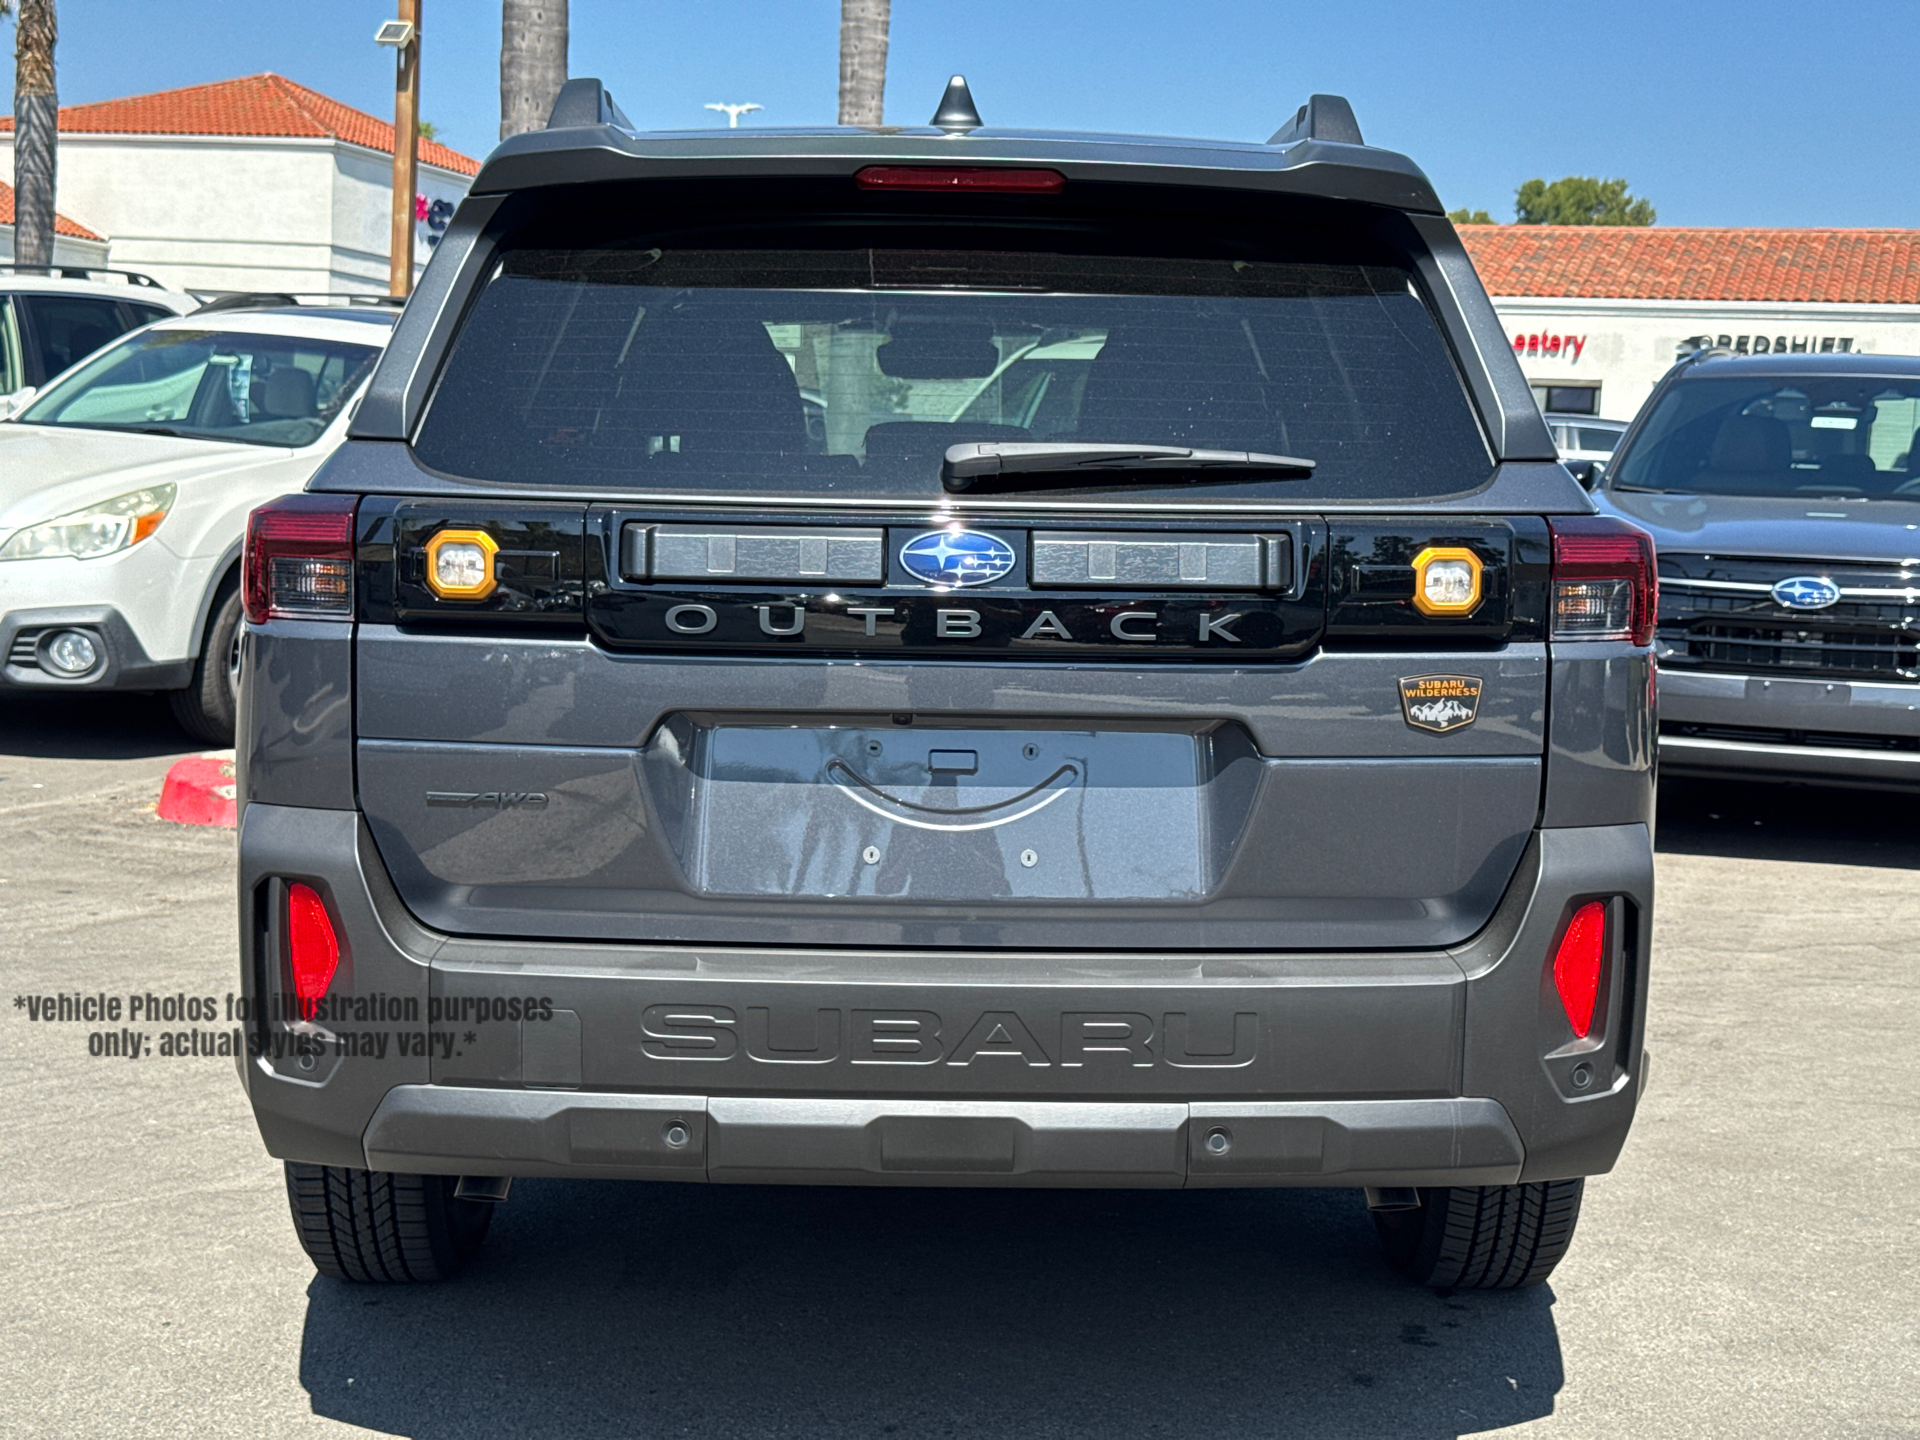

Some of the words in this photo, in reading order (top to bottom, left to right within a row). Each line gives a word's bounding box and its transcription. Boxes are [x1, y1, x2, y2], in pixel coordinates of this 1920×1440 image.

[664, 604, 1242, 642] OUTBACK
[1418, 680, 1465, 689] SUBARU
[1405, 687, 1478, 697] WILDERNESS
[471, 791, 549, 803] AWD
[641, 1003, 1257, 1068] SUBARU
